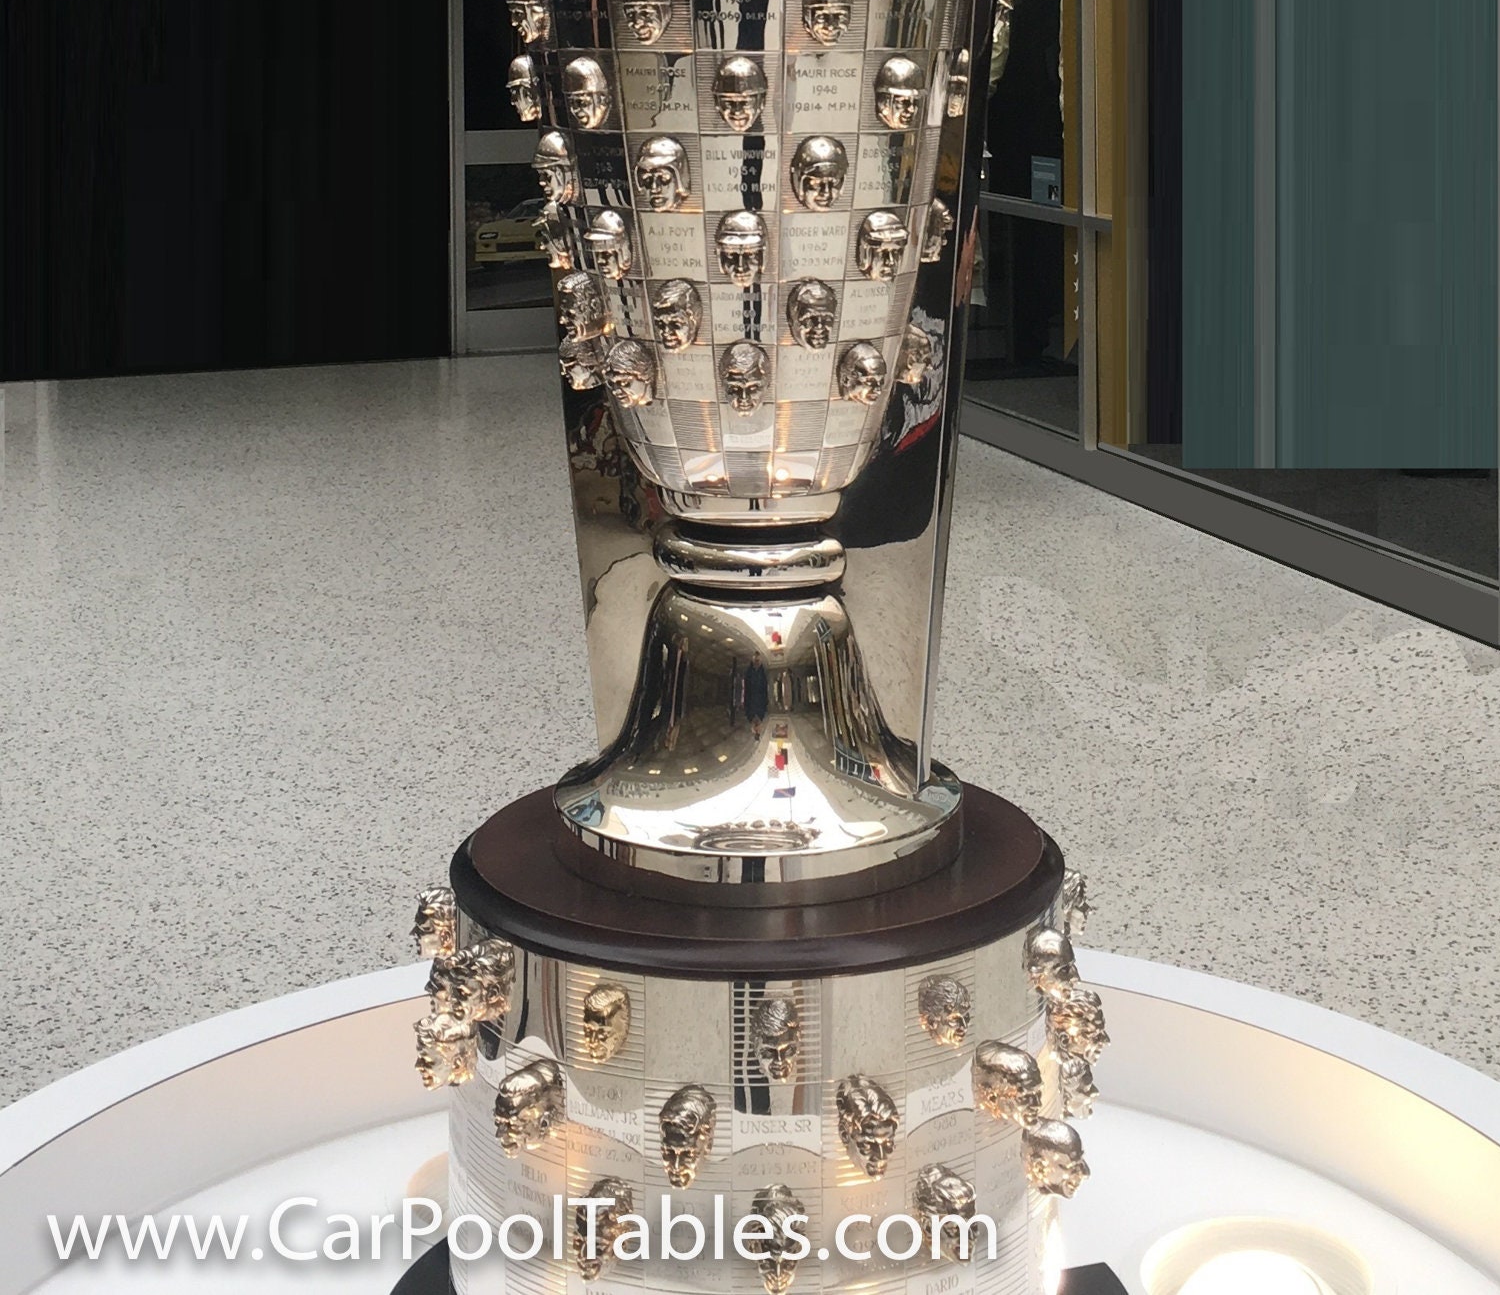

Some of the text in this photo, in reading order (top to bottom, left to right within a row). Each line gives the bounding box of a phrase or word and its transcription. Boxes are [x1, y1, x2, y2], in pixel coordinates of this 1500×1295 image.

[829, 67, 858, 78] ROSE
[812, 85, 838, 95] 1948
[705, 150, 728, 161] BILL
[728, 166, 757, 179] 1954
[668, 226, 695, 238] FOYT
[794, 1118, 813, 1133] SR
